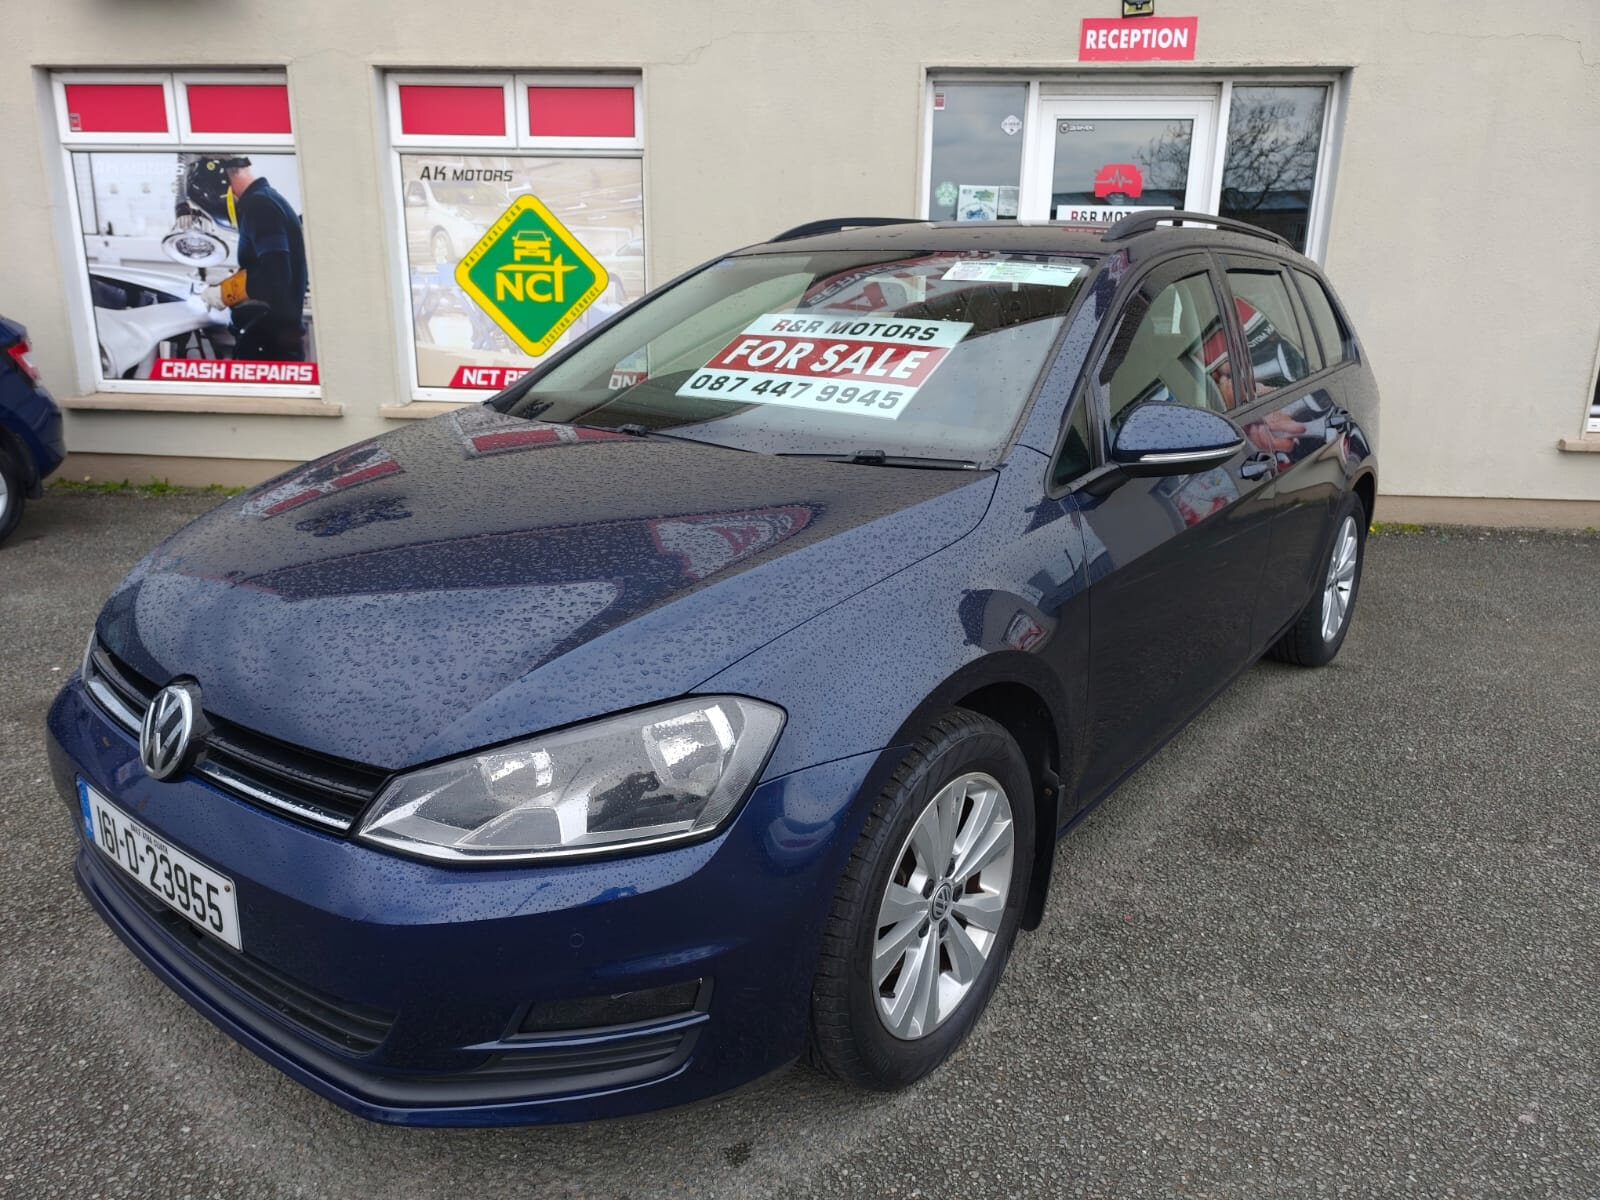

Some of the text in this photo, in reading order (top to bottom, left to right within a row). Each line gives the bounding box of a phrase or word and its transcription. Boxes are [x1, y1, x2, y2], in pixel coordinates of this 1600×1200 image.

[1085, 28, 1189, 49] RECEPTION
[420, 166, 513, 182] AK MOTORS
[1071, 210, 1097, 221] R&R
[495, 253, 579, 303] NCT
[771, 319, 939, 340] R&R MOTORS
[722, 339, 930, 379] FOR SALE
[161, 361, 313, 381] CRASH REPAIRS
[462, 368, 500, 385] NCT
[690, 374, 903, 409] 087 447 9945
[97, 805, 223, 933] 161-D-23955
